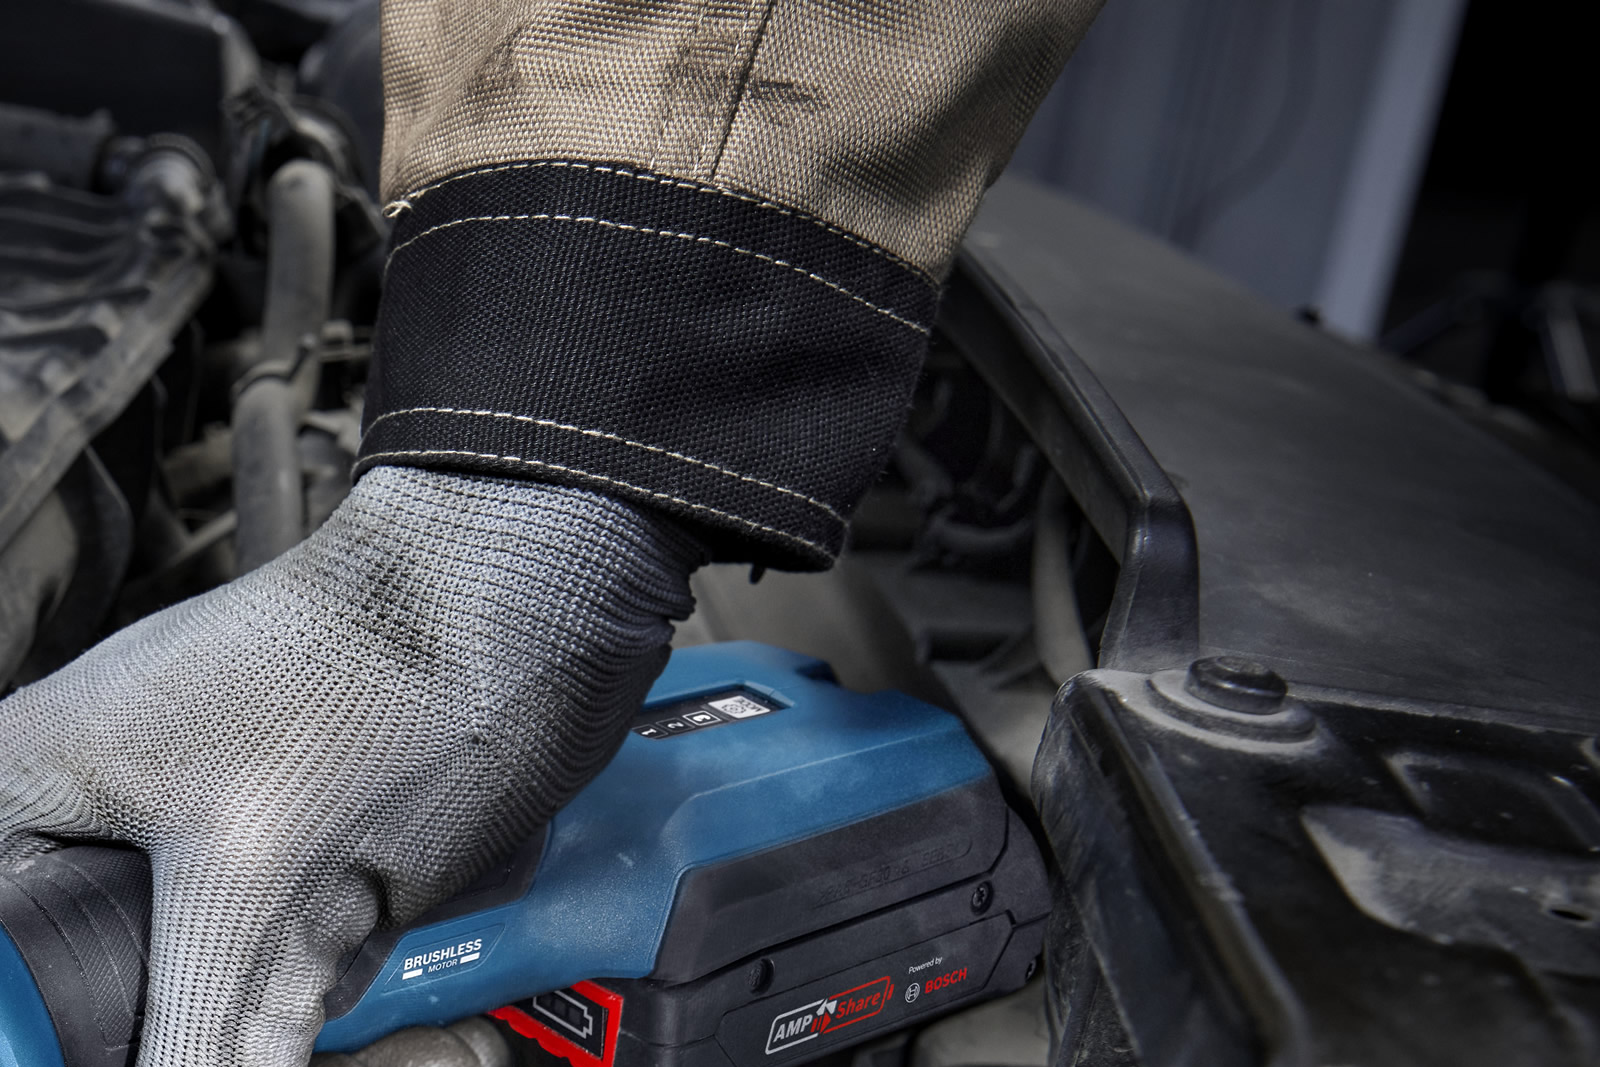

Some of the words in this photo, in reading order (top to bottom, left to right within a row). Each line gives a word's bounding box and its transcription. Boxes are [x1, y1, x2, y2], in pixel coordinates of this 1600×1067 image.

[404, 939, 482, 970] BRUSHLESS
[428, 959, 458, 972] MOTOR
[908, 959, 935, 975] Powered
[934, 956, 943, 968] by
[924, 966, 968, 994] BOSCH
[772, 1013, 813, 1043] AMP
[835, 991, 881, 1020] Share
